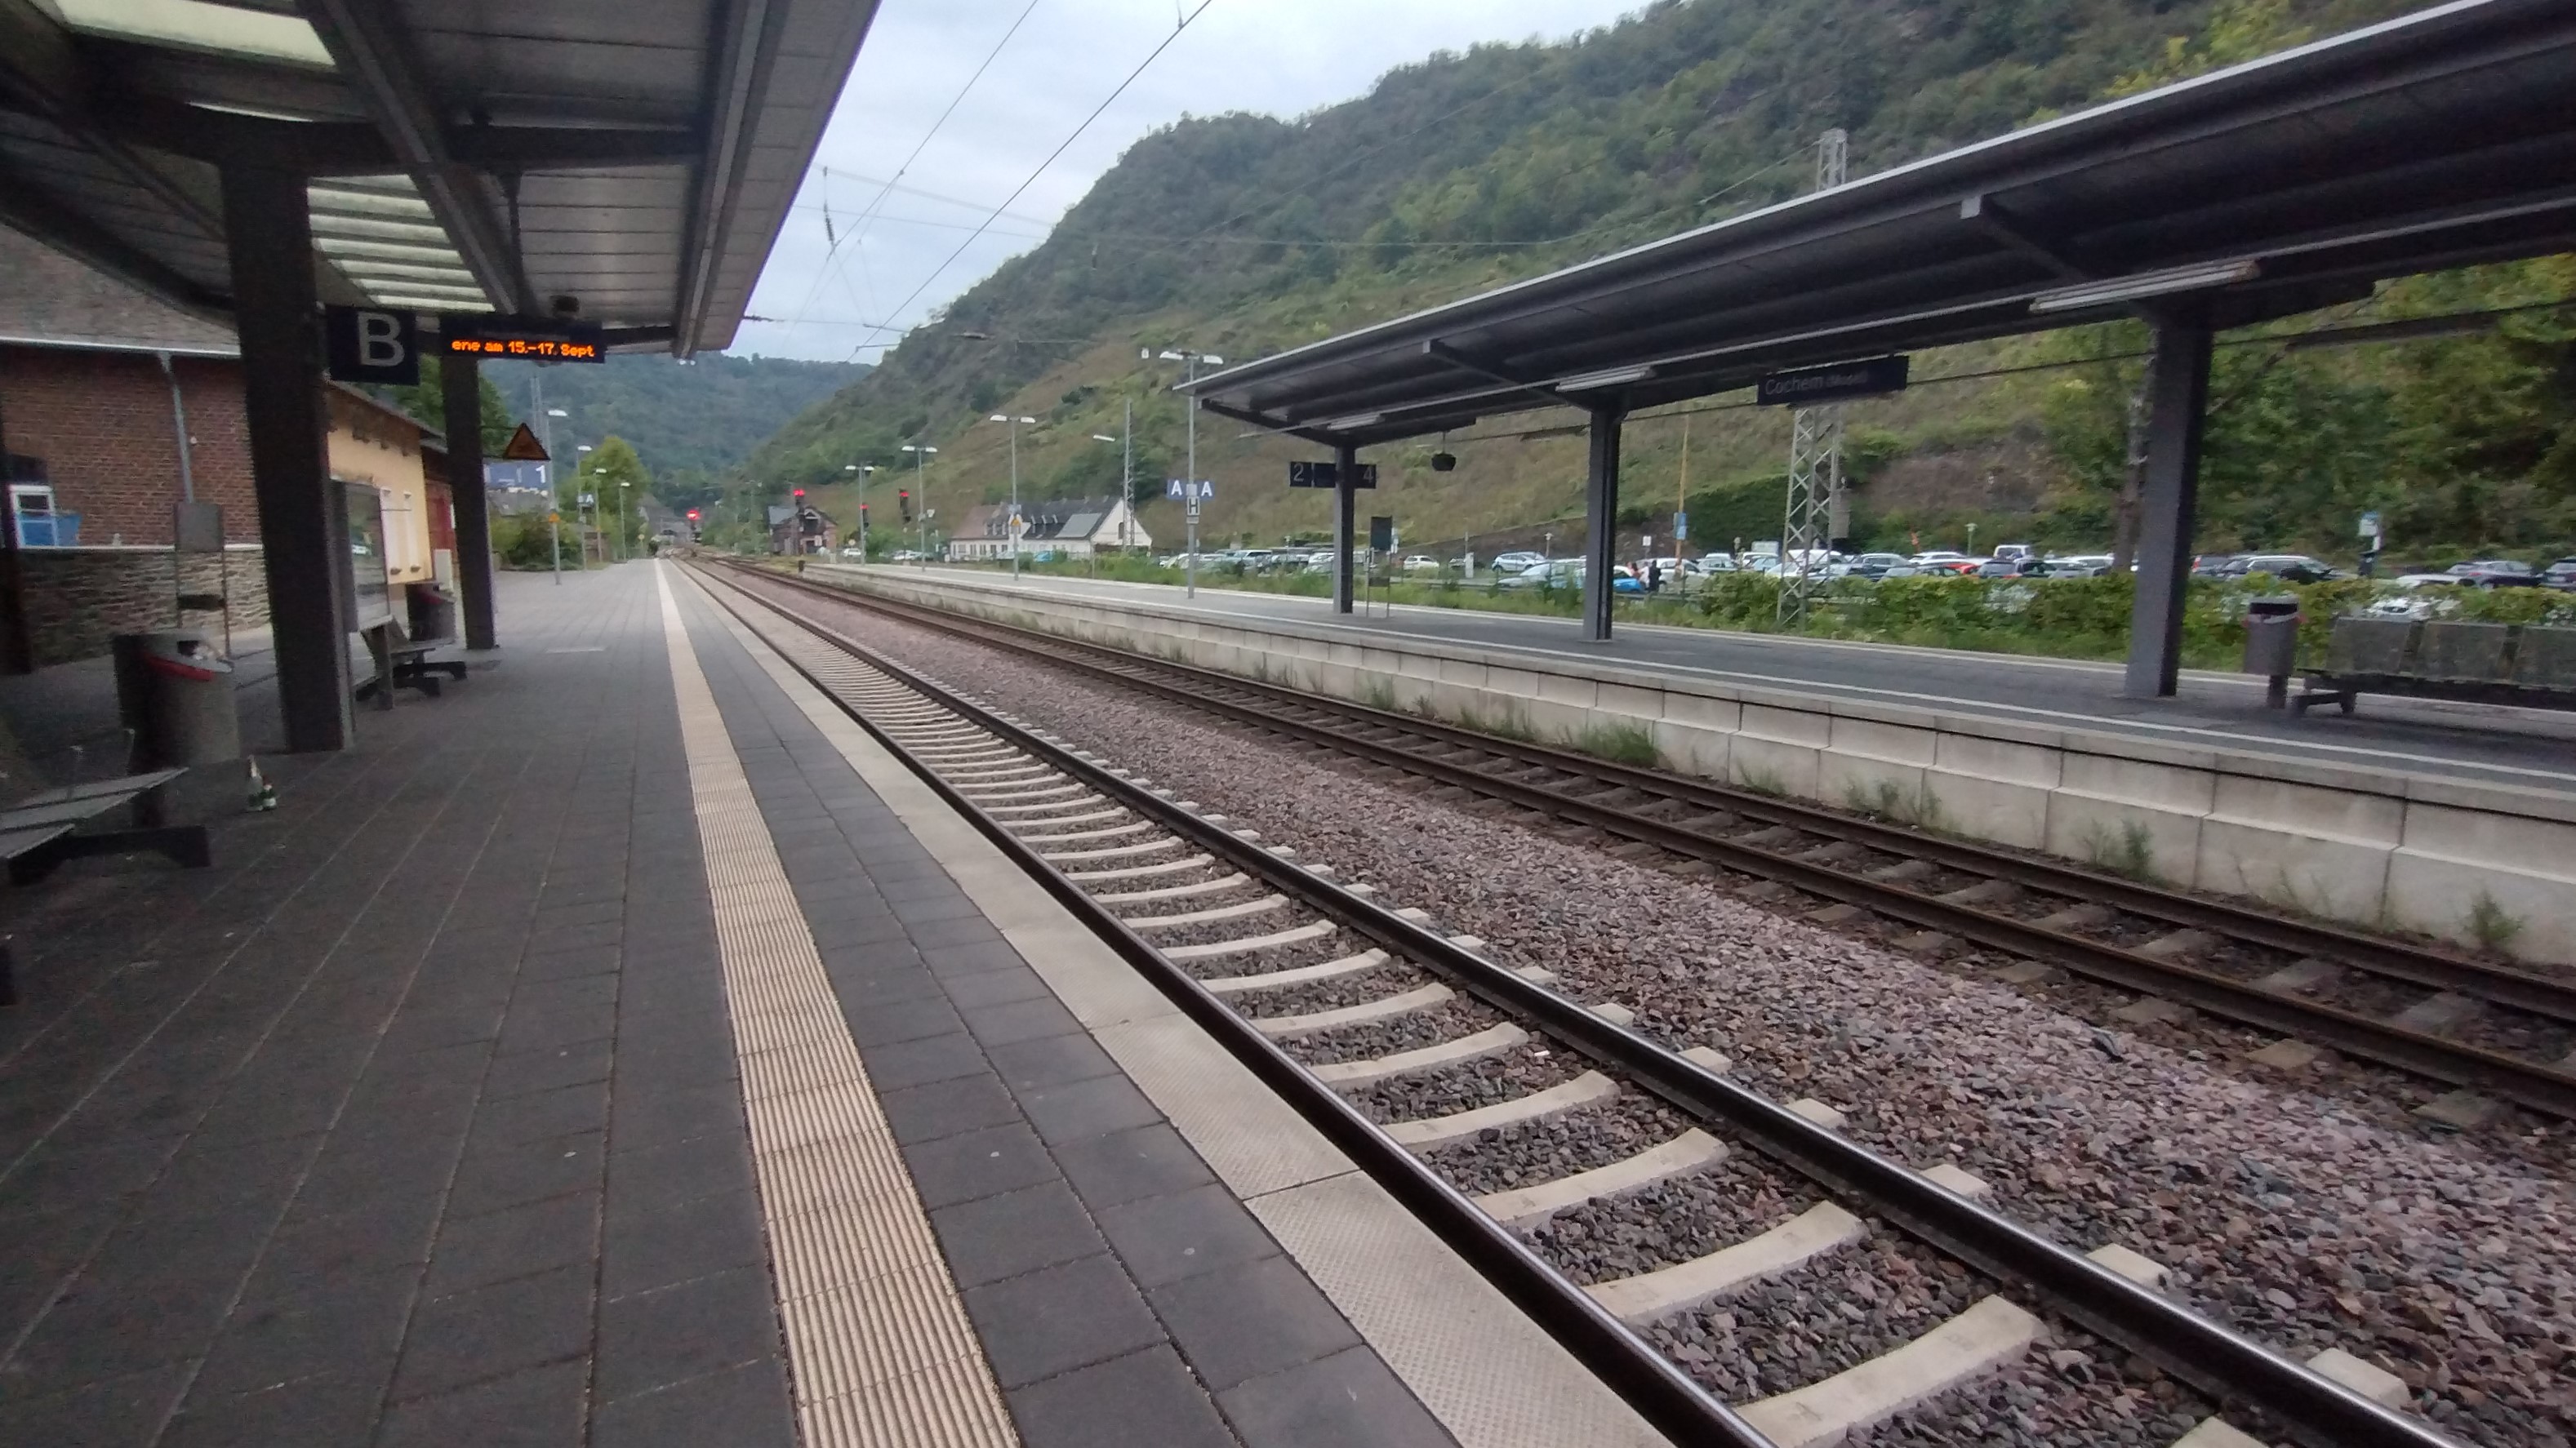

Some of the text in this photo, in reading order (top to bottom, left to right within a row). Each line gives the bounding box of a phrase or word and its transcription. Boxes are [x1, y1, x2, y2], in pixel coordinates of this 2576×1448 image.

[358, 311, 406, 367] B
[452, 339, 481, 352] ene
[484, 340, 504, 353] am
[1765, 375, 1824, 395] Cochem
[536, 464, 546, 484] 1
[1293, 463, 1305, 482] 2
[1363, 466, 1374, 483] 4
[1171, 479, 1183, 496] A
[1200, 481, 1213, 497] A
[1188, 498, 1199, 514] H
